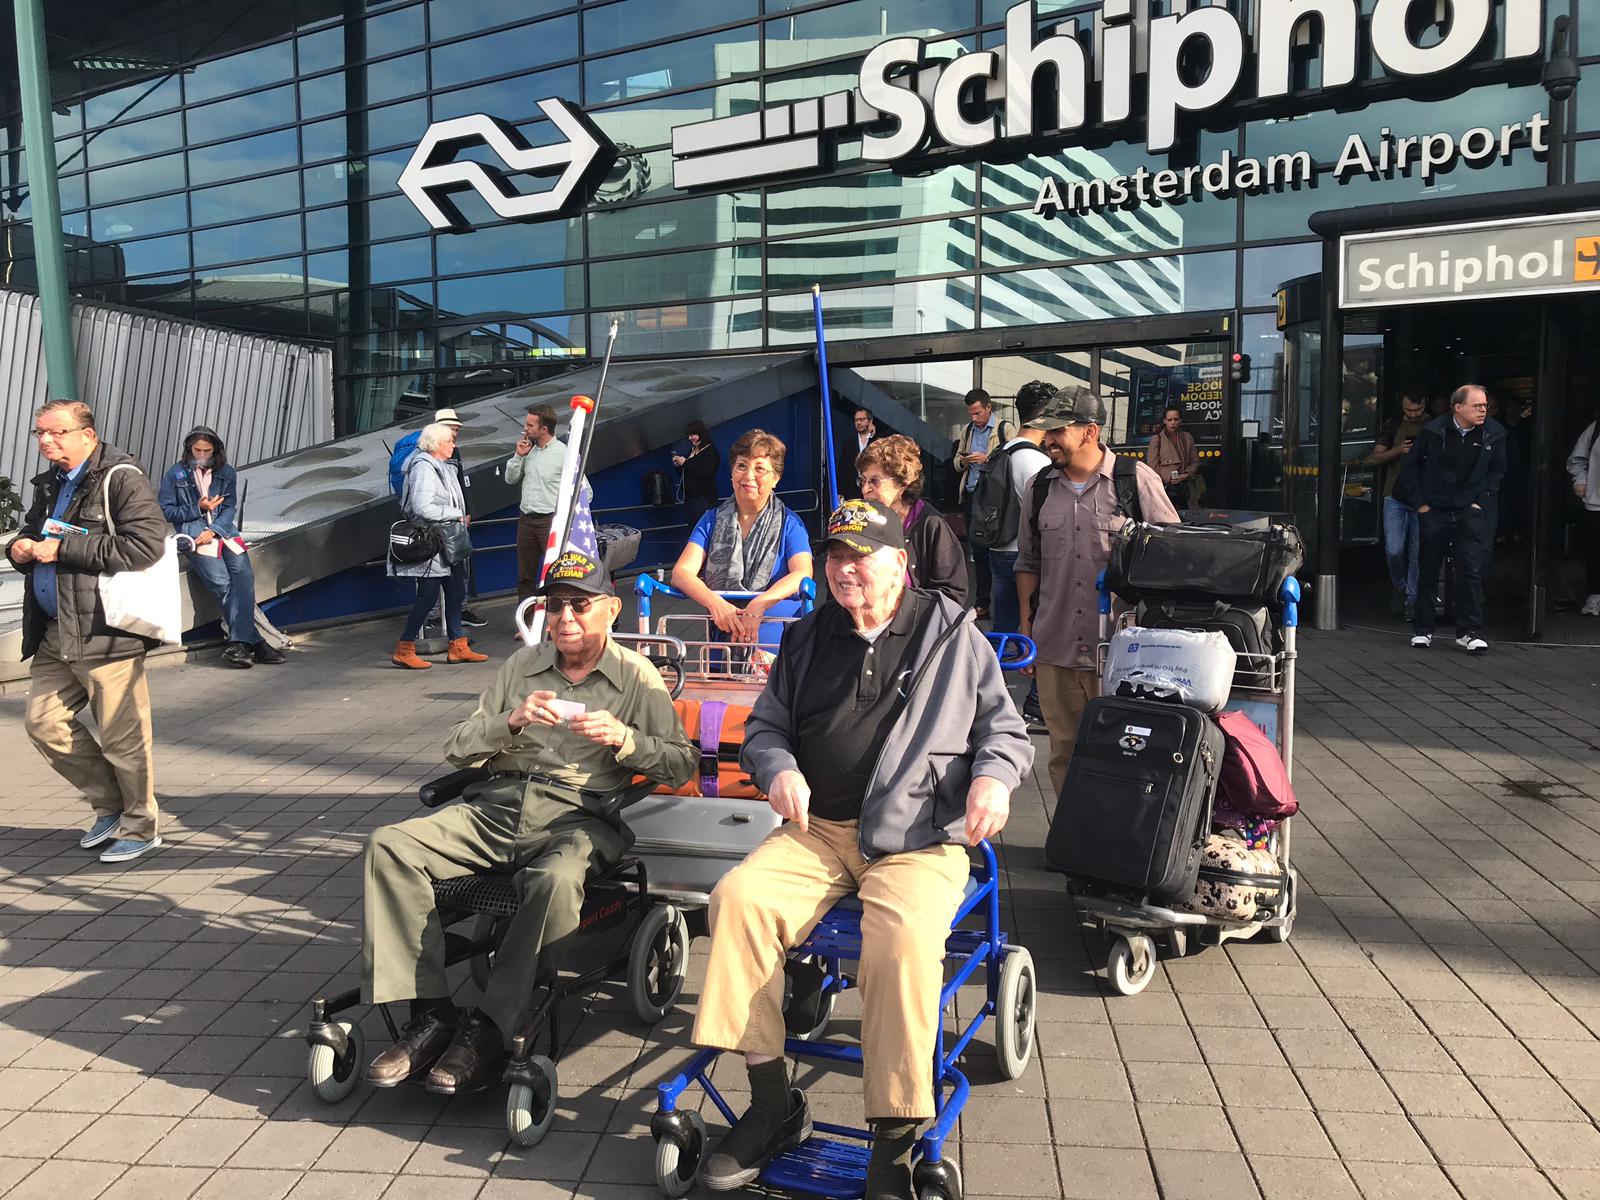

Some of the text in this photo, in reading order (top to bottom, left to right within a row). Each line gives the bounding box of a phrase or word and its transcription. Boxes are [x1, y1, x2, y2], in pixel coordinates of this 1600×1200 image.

[1033, 111, 1549, 214] Amsterdam Airport
[1358, 239, 1563, 292] Schiphol
[553, 570, 584, 578] VETERAN
[571, 553, 587, 565] WAR
